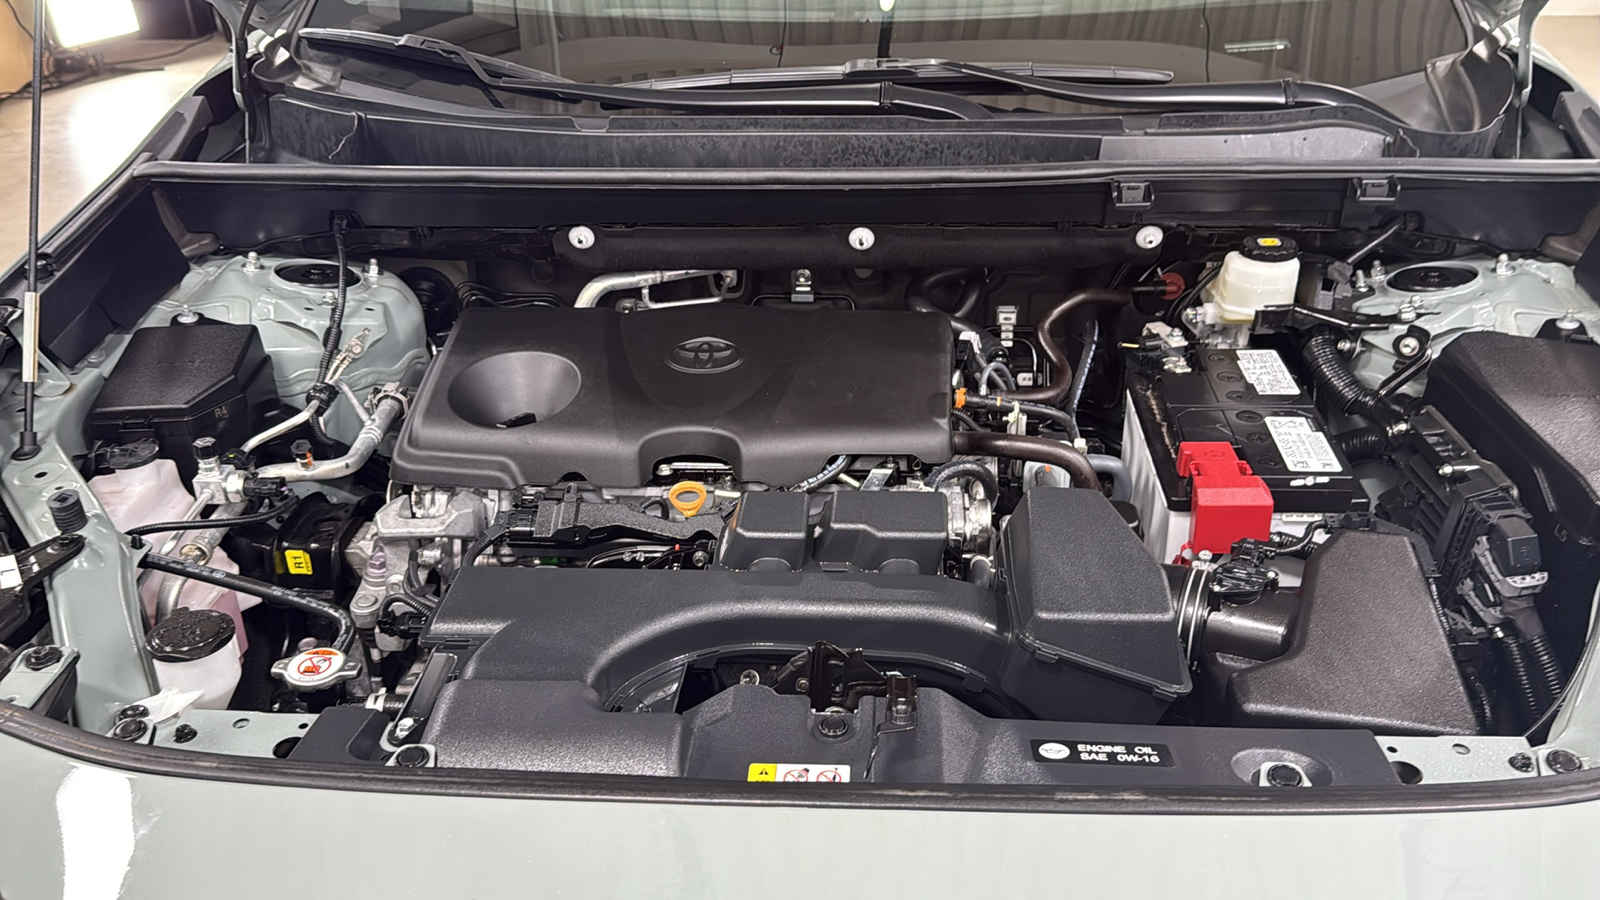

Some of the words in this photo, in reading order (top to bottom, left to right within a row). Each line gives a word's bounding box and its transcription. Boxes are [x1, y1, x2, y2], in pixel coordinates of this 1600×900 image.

[214, 405, 228, 419] R4
[293, 555, 304, 569] R1
[1077, 744, 1127, 753] ENGINE
[1134, 746, 1158, 754] OIL
[1080, 752, 1108, 761] SAE
[1117, 755, 1160, 763] 0W-16
